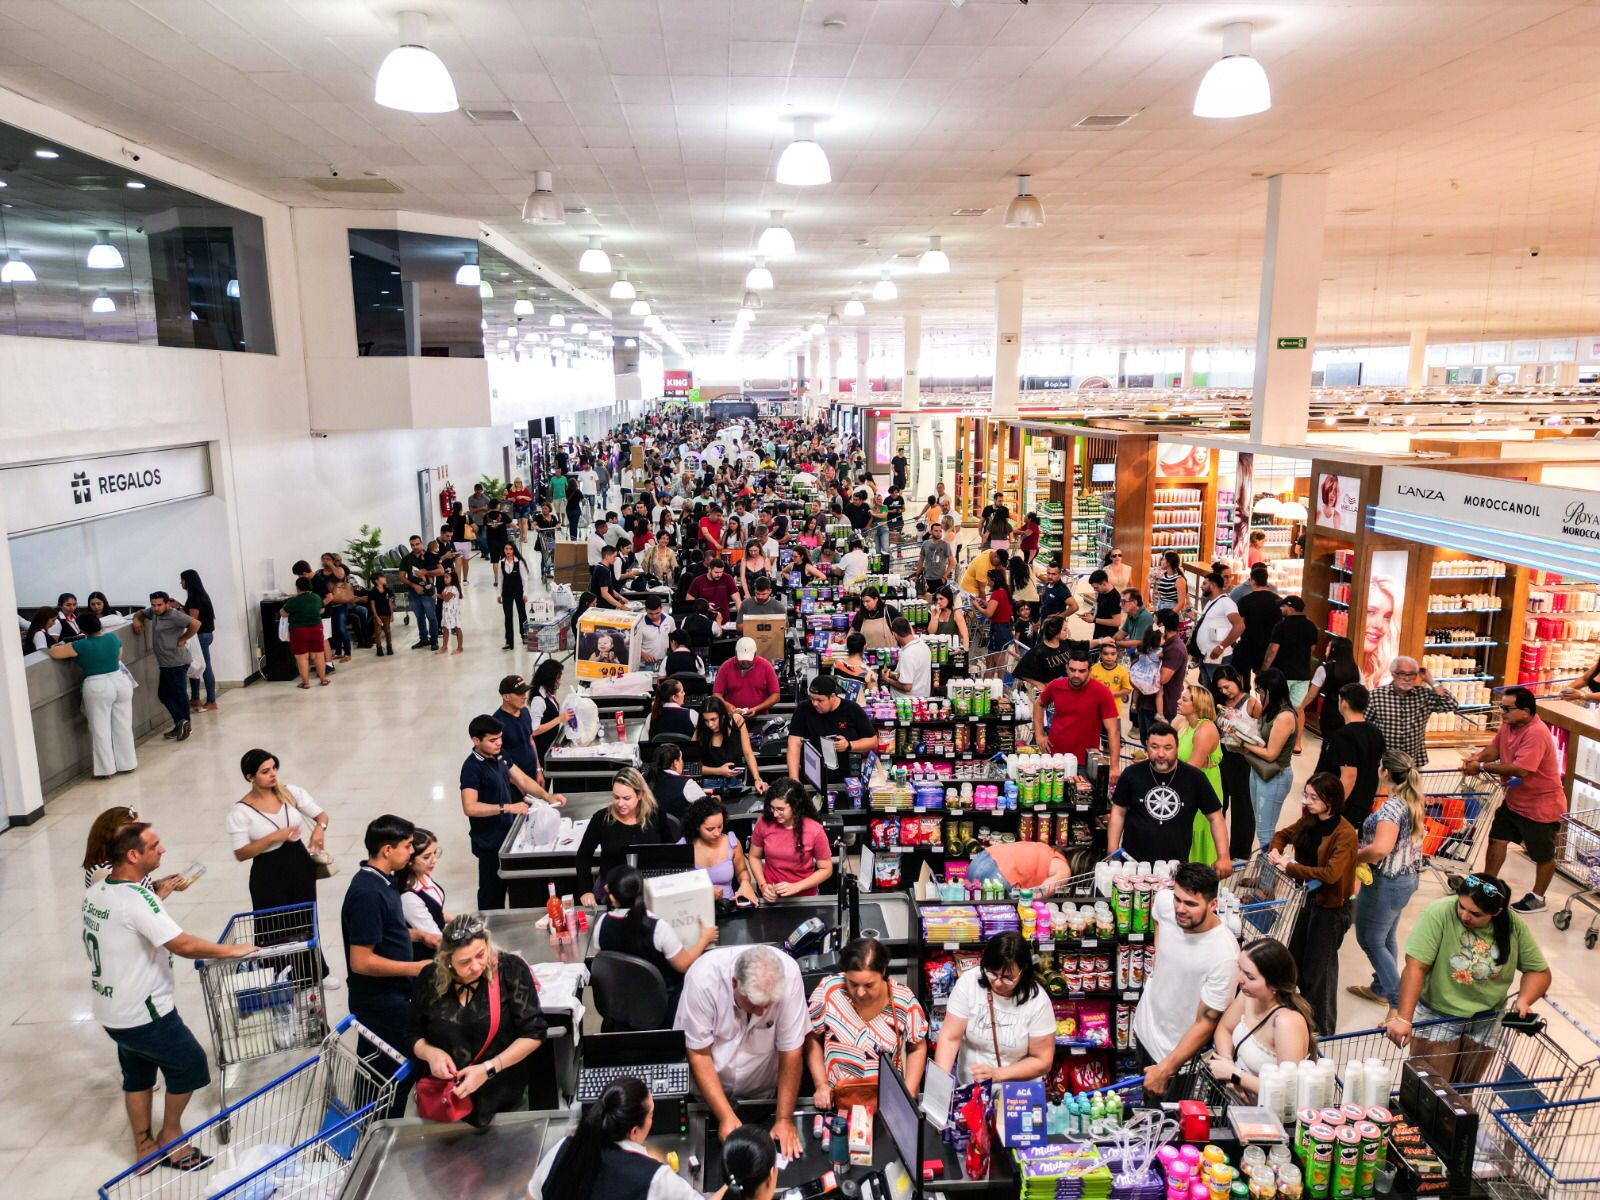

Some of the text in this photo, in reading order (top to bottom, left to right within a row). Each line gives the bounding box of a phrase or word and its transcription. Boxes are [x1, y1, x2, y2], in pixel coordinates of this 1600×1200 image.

[666, 378, 688, 387] KING
[98, 468, 162, 494] REGALOS
[1463, 495, 1541, 517] MOROCCANOIL
[1562, 500, 1600, 526] ROYA
[1562, 525, 1600, 540] MOROCCA
[86, 903, 111, 920] Sicredi
[1030, 1144, 1063, 1157] Milka
[1040, 1160, 1070, 1173] Milk
